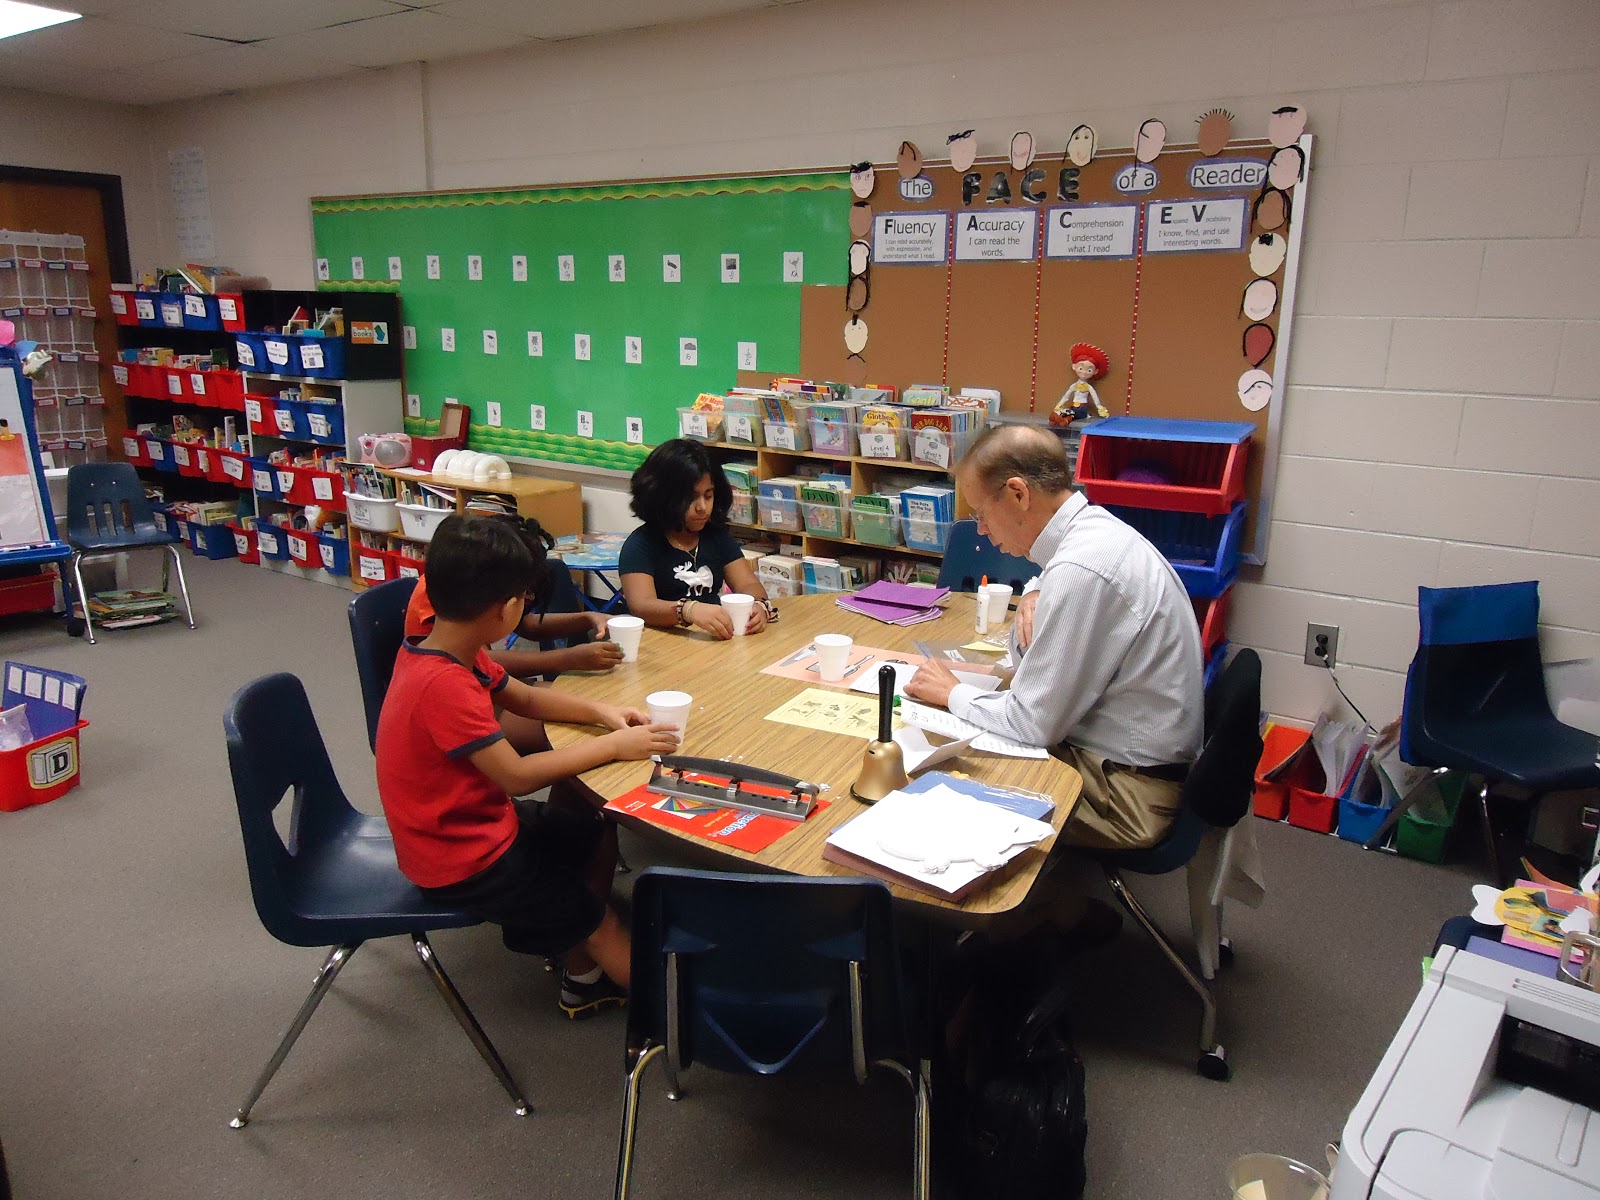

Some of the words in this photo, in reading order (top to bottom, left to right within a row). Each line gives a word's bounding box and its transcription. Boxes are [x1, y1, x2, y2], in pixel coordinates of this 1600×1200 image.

[902, 180, 931, 196] The
[962, 168, 1081, 206] FACE
[1119, 169, 1138, 190] of
[1144, 172, 1154, 187] a
[1193, 164, 1265, 186] Reader
[966, 215, 1025, 233] Accuracy
[1059, 211, 1124, 229] Comprehension
[884, 218, 936, 237] Fluency
[1072, 234, 1114, 242] understand
[1164, 230, 1183, 238] know,
[1186, 228, 1200, 237] find,
[1202, 228, 1216, 236] and
[969, 238, 973, 246] I
[989, 237, 1005, 246] read
[1008, 236, 1020, 245] the
[1164, 238, 1198, 247] interesting
[1200, 238, 1222, 246] words.
[982, 248, 1005, 257] words.
[1068, 245, 1086, 253] what
[1093, 244, 1110, 252] read
[923, 449, 938, 457] Level
[52, 752, 68, 774] D
